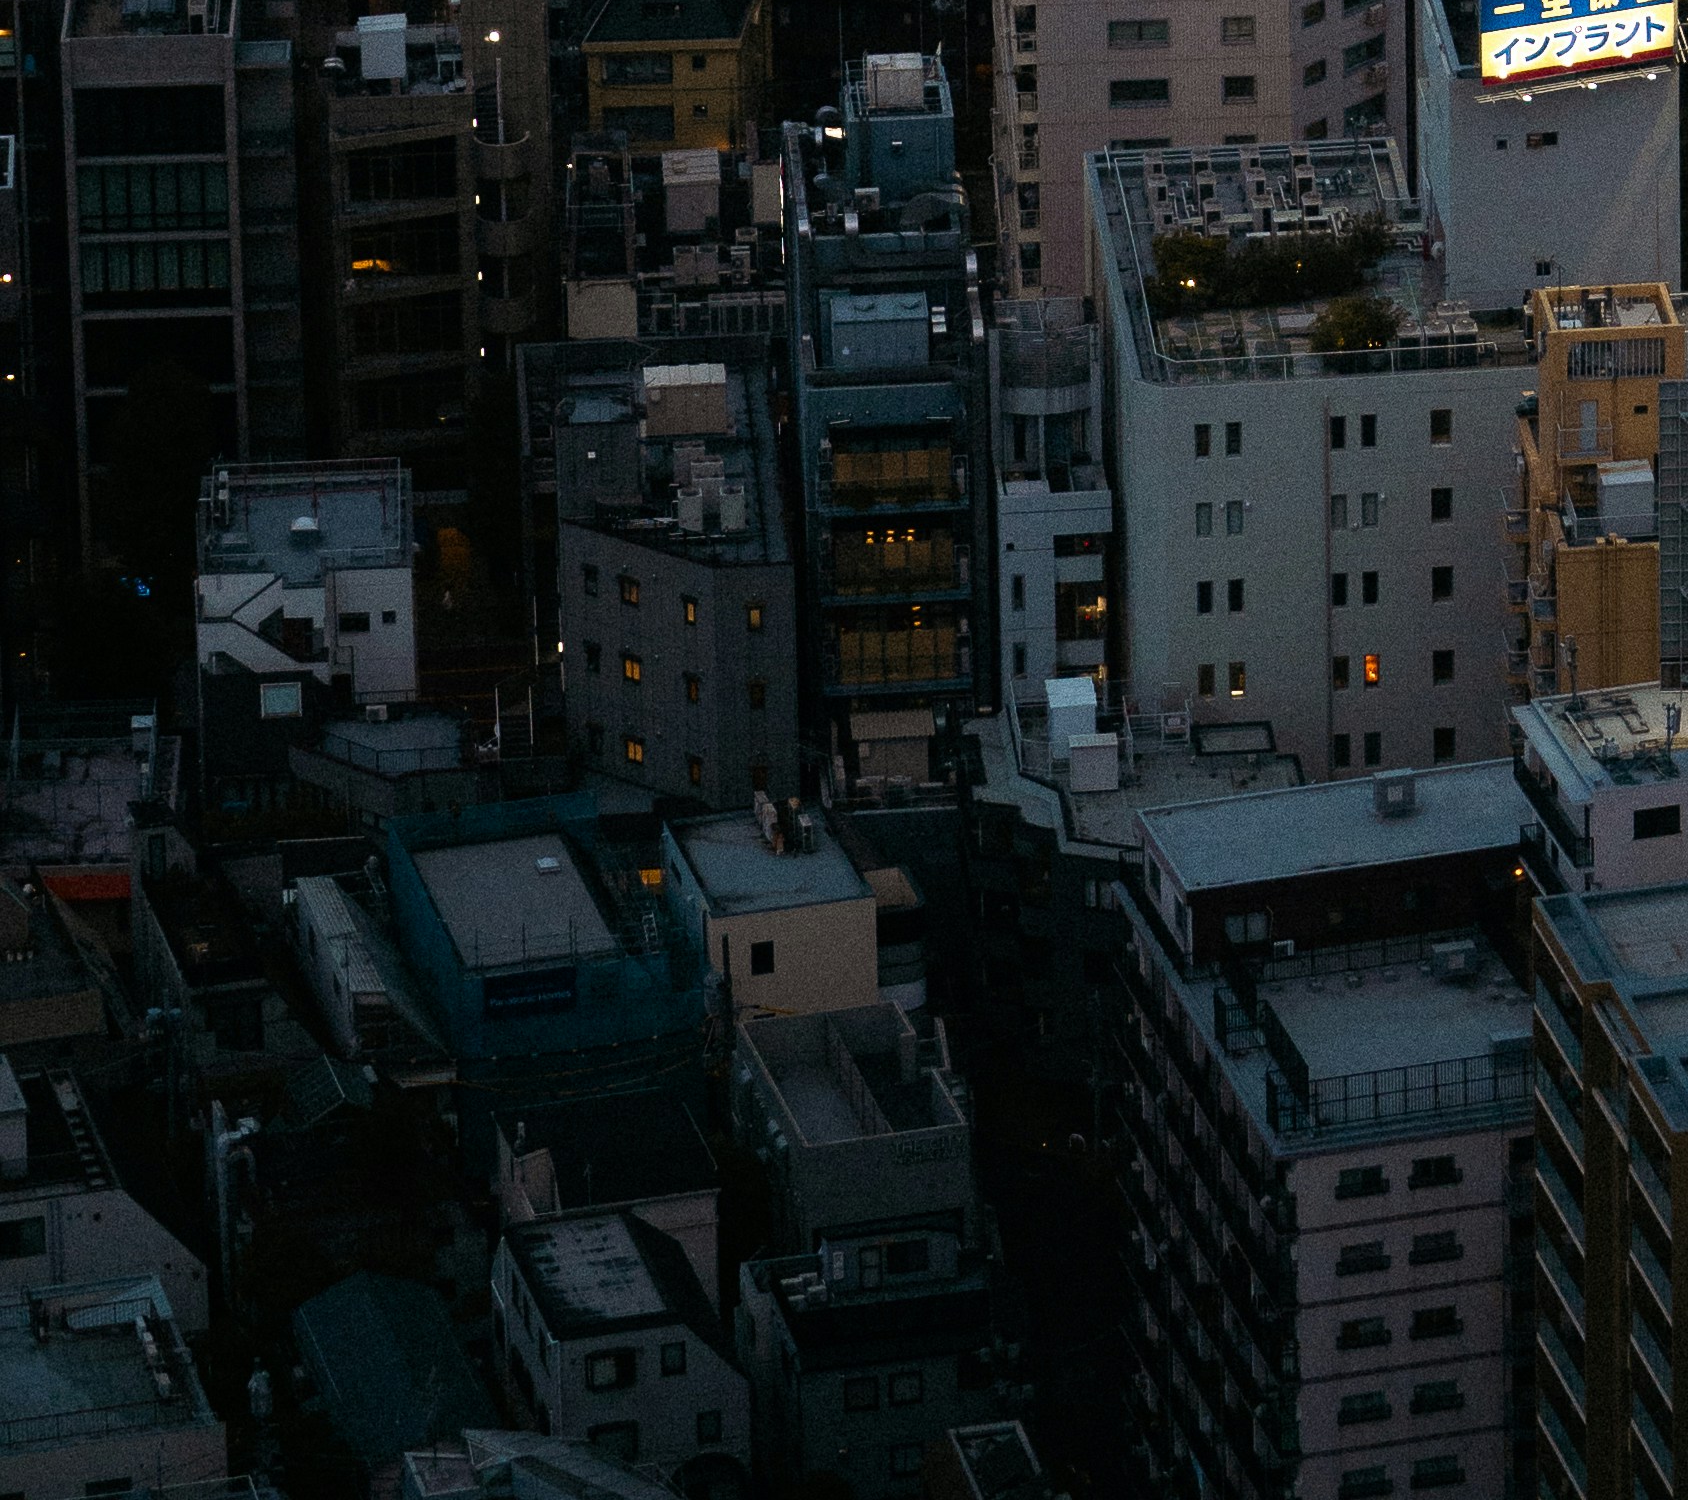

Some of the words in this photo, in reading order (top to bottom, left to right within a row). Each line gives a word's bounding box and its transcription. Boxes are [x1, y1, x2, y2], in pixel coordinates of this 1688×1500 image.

[1494, 16, 1665, 66] インプラント
